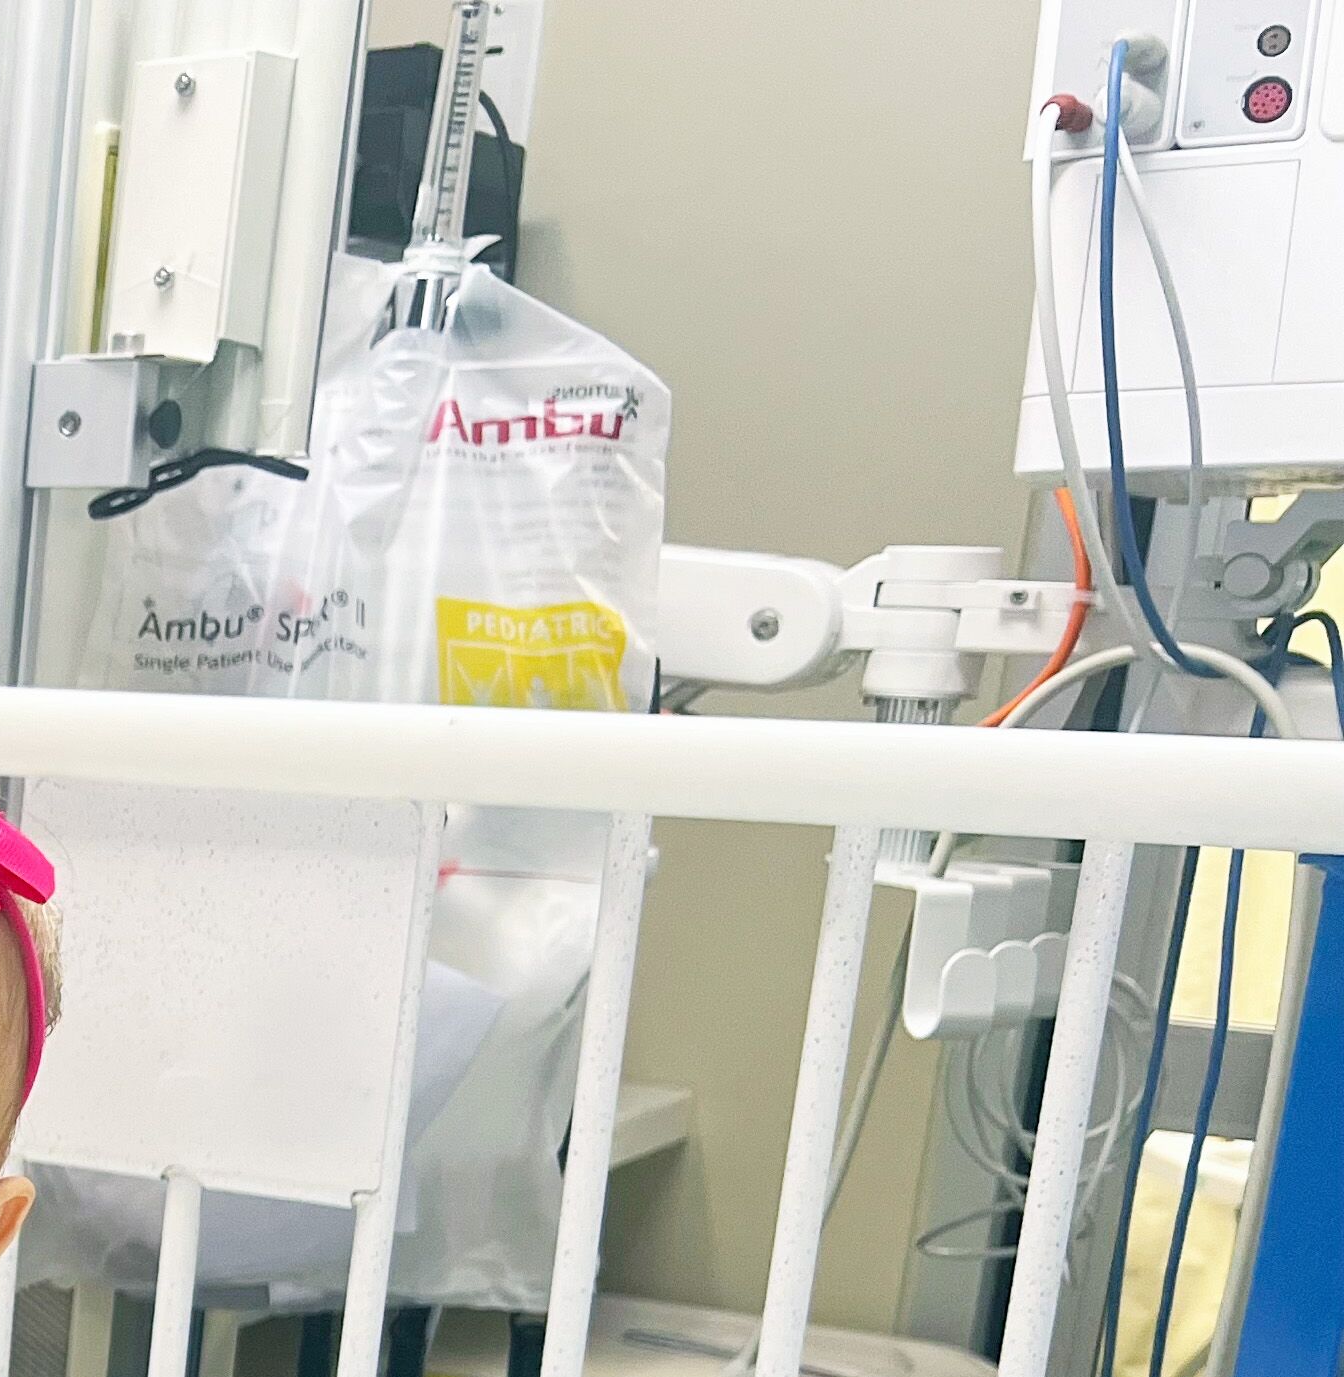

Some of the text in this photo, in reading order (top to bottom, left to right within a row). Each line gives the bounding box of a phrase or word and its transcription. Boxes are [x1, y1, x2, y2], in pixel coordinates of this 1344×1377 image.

[428, 397, 623, 446] Ambu
[467, 611, 612, 643] PEDIATRIC
[134, 653, 190, 675] Single
